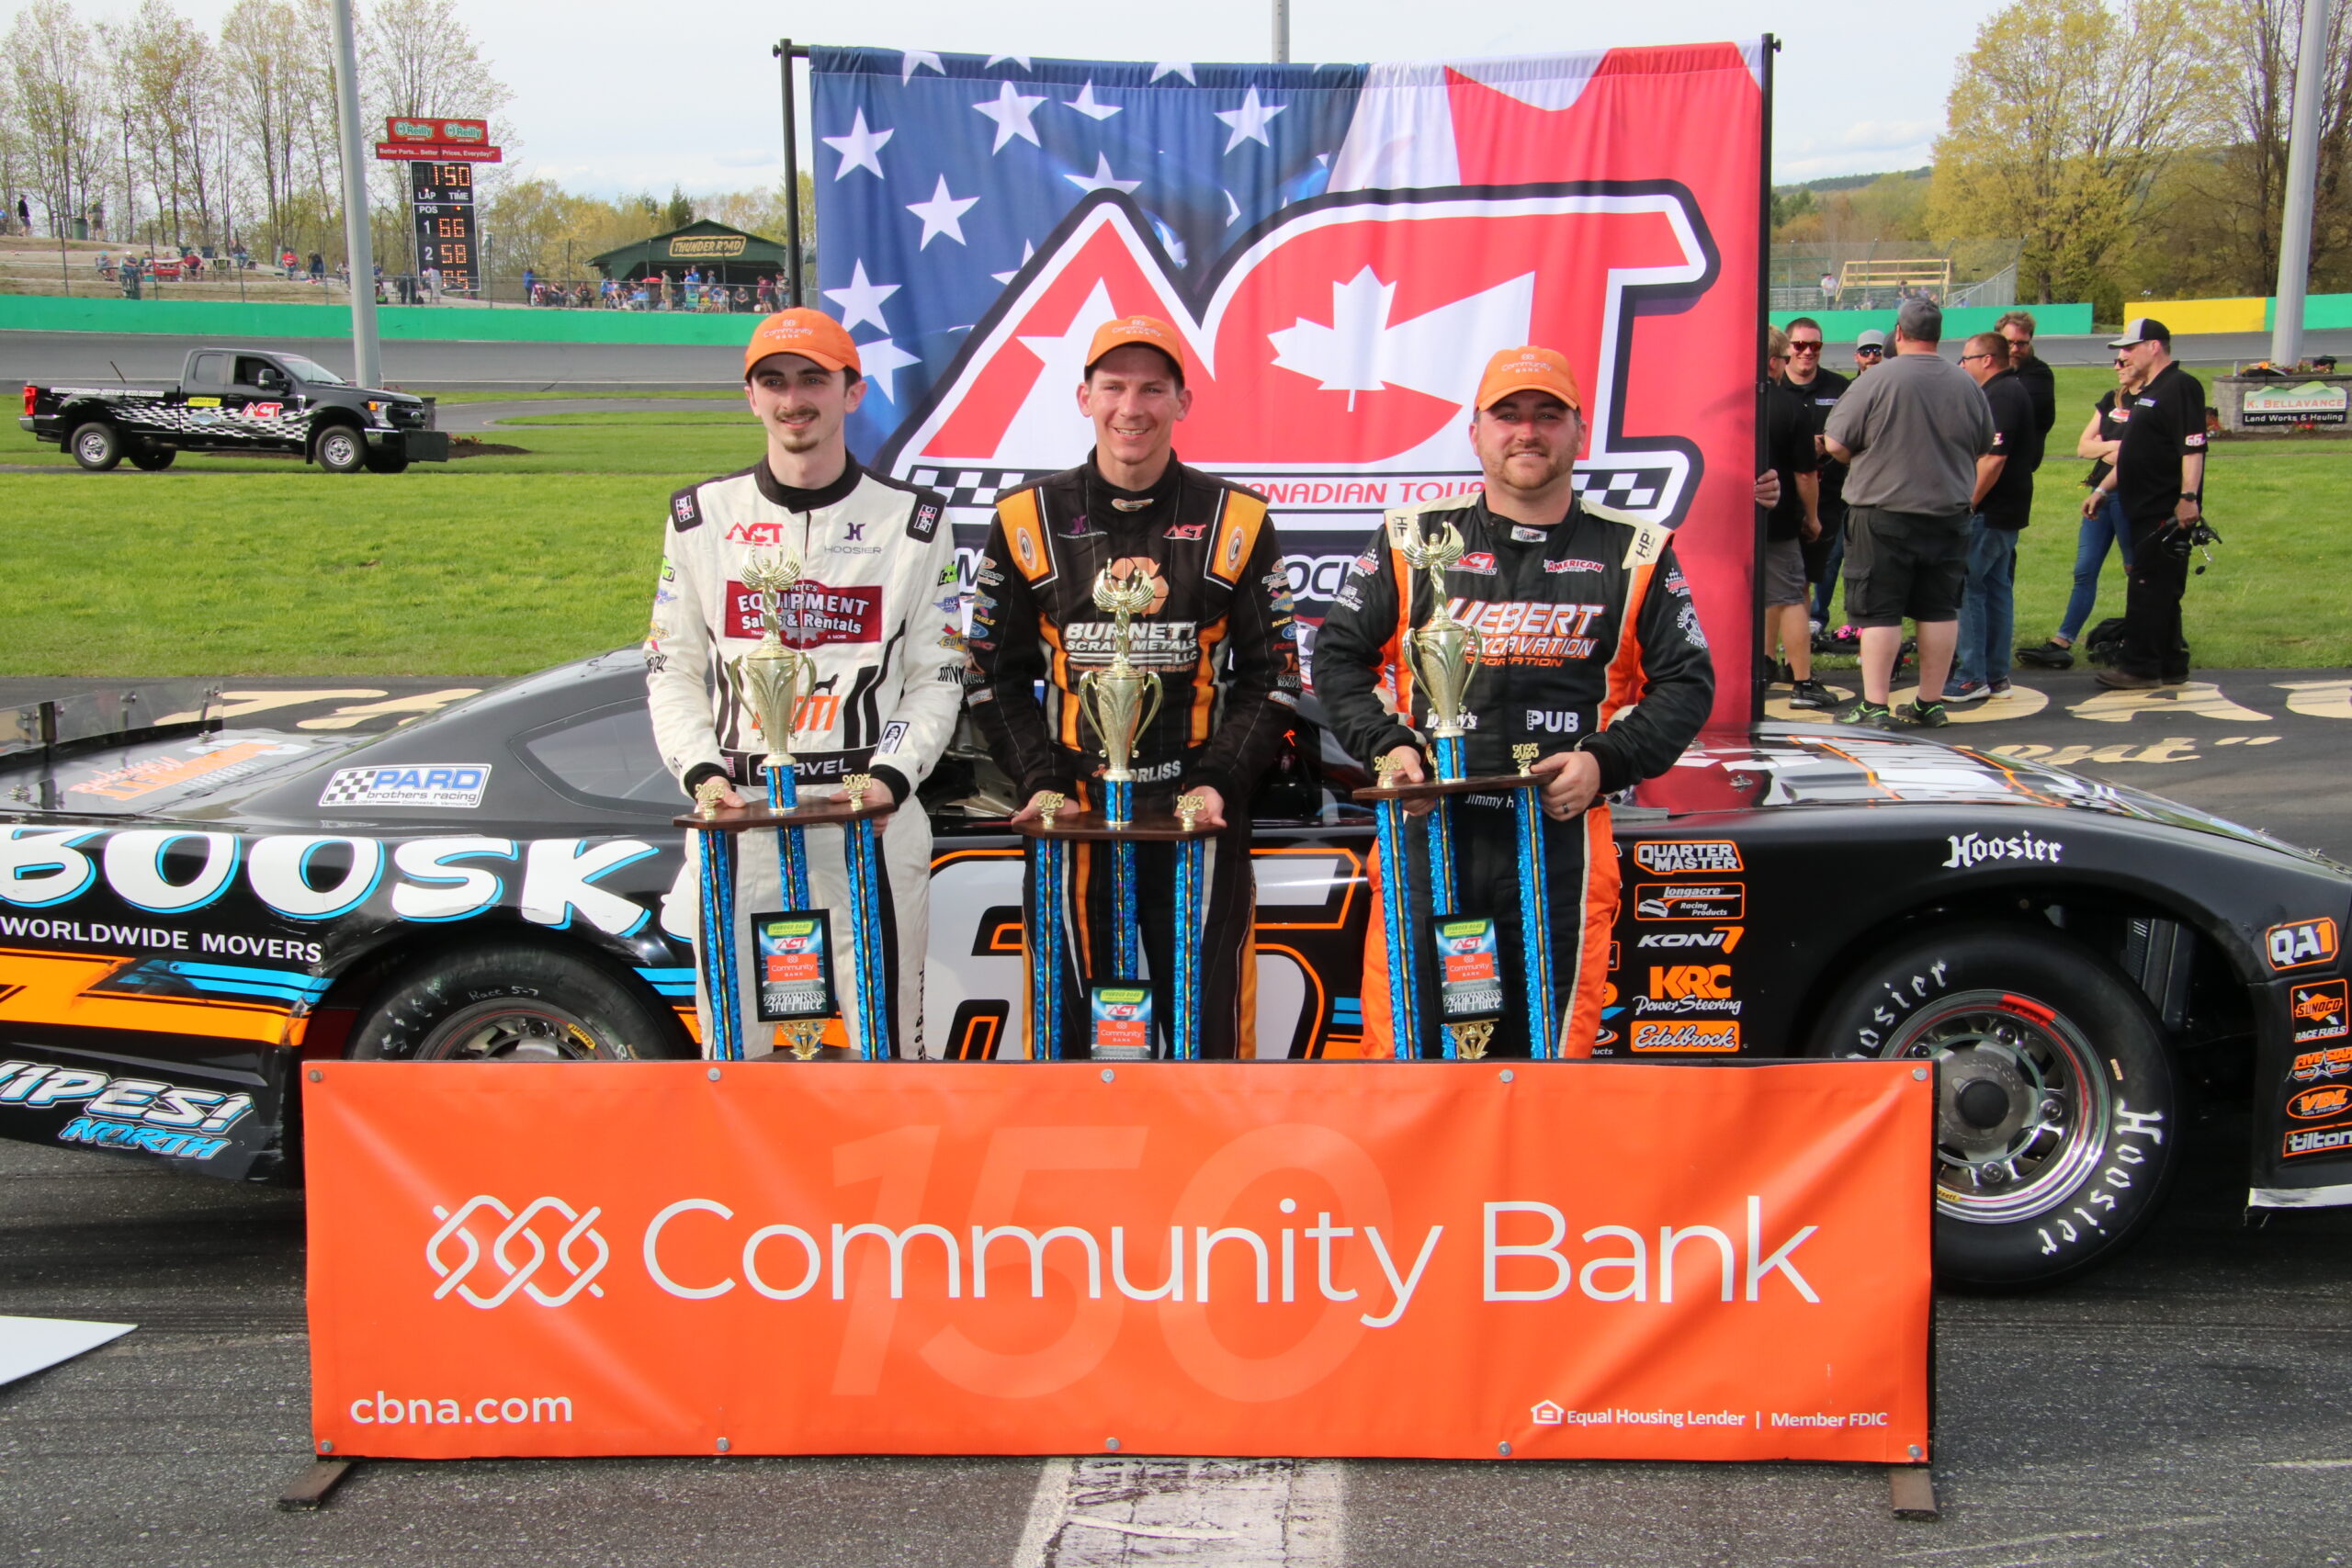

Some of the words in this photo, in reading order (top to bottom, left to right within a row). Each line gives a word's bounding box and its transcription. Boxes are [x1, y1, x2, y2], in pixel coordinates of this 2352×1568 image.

[395, 122, 434, 138] O'Reilly
[446, 123, 482, 139] O'Reilly
[418, 192, 436, 200] LAP
[448, 192, 469, 200] TIME
[419, 206, 438, 214] POS
[424, 220, 431, 235] 1
[438, 218, 465, 238] 66
[424, 246, 433, 261] 2
[441, 243, 467, 264] 58
[673, 240, 716, 254] THUNDER
[716, 239, 742, 252] ROAD
[240, 402, 283, 418] ACT
[2264, 399, 2344, 409] BELLAVANCE
[2268, 414, 2297, 423] Works
[2310, 413, 2344, 422] Hauling
[725, 522, 784, 543] ACT
[1163, 525, 1206, 539] ACT
[824, 546, 882, 555] HOOSIER
[1546, 558, 1605, 573] AMERICAN
[790, 583, 818, 592] PETE'S
[741, 615, 782, 630] Sals
[786, 614, 798, 627] &
[804, 613, 862, 634] Rentals
[1272, 616, 1292, 628] RACE
[1066, 621, 1197, 641] BURNETT
[1131, 638, 1196, 651] METALS
[1175, 651, 1197, 663] LLC
[1465, 656, 1565, 668] RPORATION
[1527, 709, 1578, 733] PUB
[1512, 742, 1540, 759] 2023
[756, 758, 853, 777] GAVEL
[1129, 760, 1182, 783] RLISS
[1374, 756, 1403, 772] 2023
[371, 769, 483, 790] PARD
[842, 773, 873, 790] 2023
[367, 790, 427, 800] brothers
[434, 791, 477, 803] racing
[695, 784, 725, 800] 2023
[1036, 793, 1065, 808] 2023
[1177, 795, 1205, 810] 2023
[1637, 843, 1735, 864] QUARTER
[1941, 829, 2063, 868] Hoosier
[1655, 857, 1738, 872] MASTER
[1663, 886, 1722, 898] Longacre
[1679, 902, 1709, 911] Racing
[1691, 908, 1728, 917] Products
[2, 915, 189, 950] WORLDWIDE
[201, 931, 322, 963] MOVERS
[777, 937, 808, 950] ACT
[1453, 937, 1481, 950] ACT
[1637, 933, 1726, 948] KONI
[2269, 921, 2333, 964] QA1
[772, 964, 814, 972] Community
[1449, 963, 1489, 973] Community
[1649, 964, 1732, 999] KRC
[791, 995, 822, 1010] Place
[1471, 995, 1500, 1010] Place
[1633, 996, 1678, 1016] Power
[1675, 994, 1742, 1016] Steering
[2296, 998, 2341, 1016] SUNOCO
[1106, 1005, 1137, 1016] ACT
[1101, 1029, 1141, 1038] Community
[1634, 1024, 1736, 1049] Edelbrock
[2295, 1028, 2318, 1041] RACE
[2318, 1025, 2346, 1037] FUELS
[2300, 1089, 2347, 1111] VDL
[2316, 1106, 2342, 1114] SYSTEMS
[59, 1117, 232, 1160] NORTH
[2289, 1130, 2352, 1153] tilton
[2039, 1100, 2164, 1256] Hoosier
[642, 1196, 1443, 1329] Community
[1483, 1194, 1821, 1304] Bank
[350, 1390, 572, 1424] cbna.com
[1567, 1409, 1611, 1426] Equal
[1616, 1409, 1683, 1427] Housing
[1688, 1410, 1746, 1426] Lender
[1771, 1412, 1846, 1427] Member
[1849, 1411, 1887, 1426] FDIC
